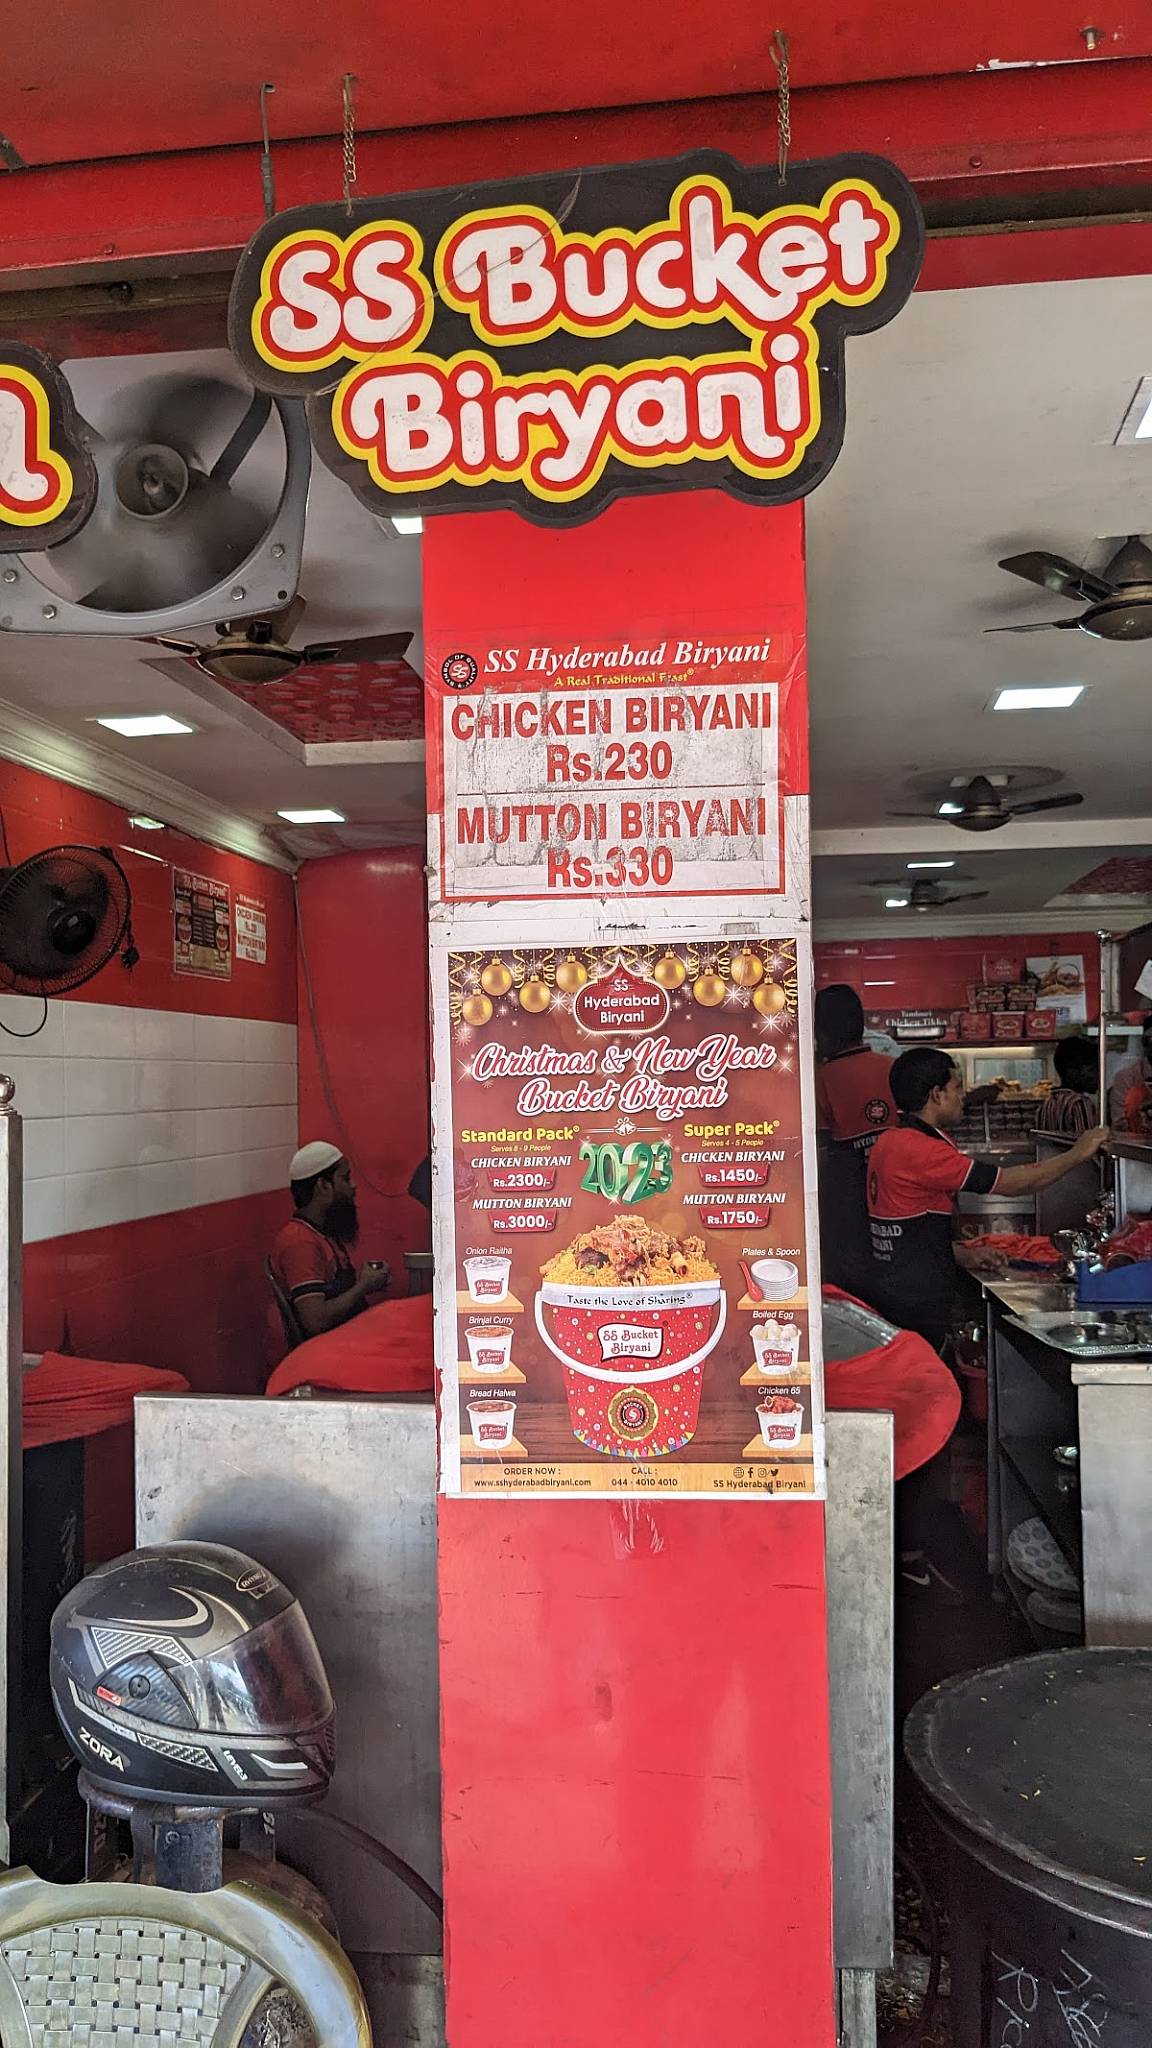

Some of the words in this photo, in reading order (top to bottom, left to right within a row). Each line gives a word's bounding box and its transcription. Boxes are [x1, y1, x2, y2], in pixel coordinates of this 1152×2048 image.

[270, 239, 416, 353] SS
[452, 195, 881, 326] Bucket
[350, 332, 802, 484] Biryani
[484, 649, 520, 673] SS
[525, 642, 667, 677] Hyderabad
[672, 638, 771, 669] Biryani
[554, 676, 564, 687] A
[567, 675, 591, 686] Real
[594, 672, 656, 685] Traditional
[451, 699, 612, 741] CHICKEN
[625, 692, 771, 734] BIRYANI
[547, 740, 673, 782] Rs.230
[457, 803, 607, 845] MUTTON
[620, 798, 766, 840] BIRYANI
[547, 845, 674, 889] Rs.330
[613, 978, 630, 991] SS
[584, 994, 660, 1012] Hyderabad
[600, 1011, 645, 1026] Biryani
[472, 1042, 597, 1082] Christmas
[601, 1047, 632, 1073] &
[629, 1036, 698, 1075] New
[694, 1034, 777, 1081] Year
[517, 1078, 616, 1116] Bucket
[617, 1074, 729, 1121] Biryani
[461, 1127, 533, 1143] Standard
[683, 1123, 731, 1140] Super
[529, 1144, 552, 1152] People
[741, 1139, 764, 1147] People
[471, 1157, 523, 1169] CHICKEN
[523, 1155, 572, 1167] BIRYANI
[681, 1152, 734, 1163] CHICKEN
[735, 1151, 785, 1162] BIRYANI
[578, 1142, 673, 1205] 2023
[705, 1169, 763, 1183] Rs.1450/-
[493, 1174, 551, 1187] Rs.2300/-
[472, 1198, 522, 1210] MUTTON
[523, 1197, 573, 1209] BIRYANI
[682, 1194, 734, 1205] MUTTON
[735, 1193, 786, 1204] BIRYANI
[493, 1215, 553, 1229] Rs.3000/-
[707, 1211, 763, 1225] Rs.1750/-
[465, 1247, 488, 1255] Onion
[742, 1248, 766, 1256] Plates
[767, 1248, 774, 1256] &
[776, 1248, 801, 1257] Spoon
[567, 1294, 592, 1305] Taste
[594, 1297, 609, 1305] the
[612, 1297, 635, 1306] Love
[636, 1296, 647, 1305] of
[468, 1316, 492, 1325] Brinjal
[493, 1316, 513, 1325] Curry
[752, 1311, 777, 1319] Boiled
[778, 1311, 794, 1319] Egg
[603, 1330, 618, 1341] SS
[621, 1329, 659, 1341] Bucket
[611, 1342, 652, 1354] Biryani
[469, 1389, 492, 1397] Bread
[493, 1389, 516, 1397] Halwa
[790, 1387, 801, 1395] 65
[535, 1467, 556, 1475] NOW
[631, 1467, 653, 1475] CALL
[474, 1478, 592, 1488] www.sshyderabadbiryani.com
[611, 1478, 628, 1486] 044
[636, 1478, 656, 1486] 4010
[657, 1478, 678, 1486] 4010
[713, 1480, 725, 1488] SS
[726, 1480, 774, 1489] Hyderabad
[775, 1479, 806, 1489] Biryani
[79, 1727, 125, 1773] ZORA
